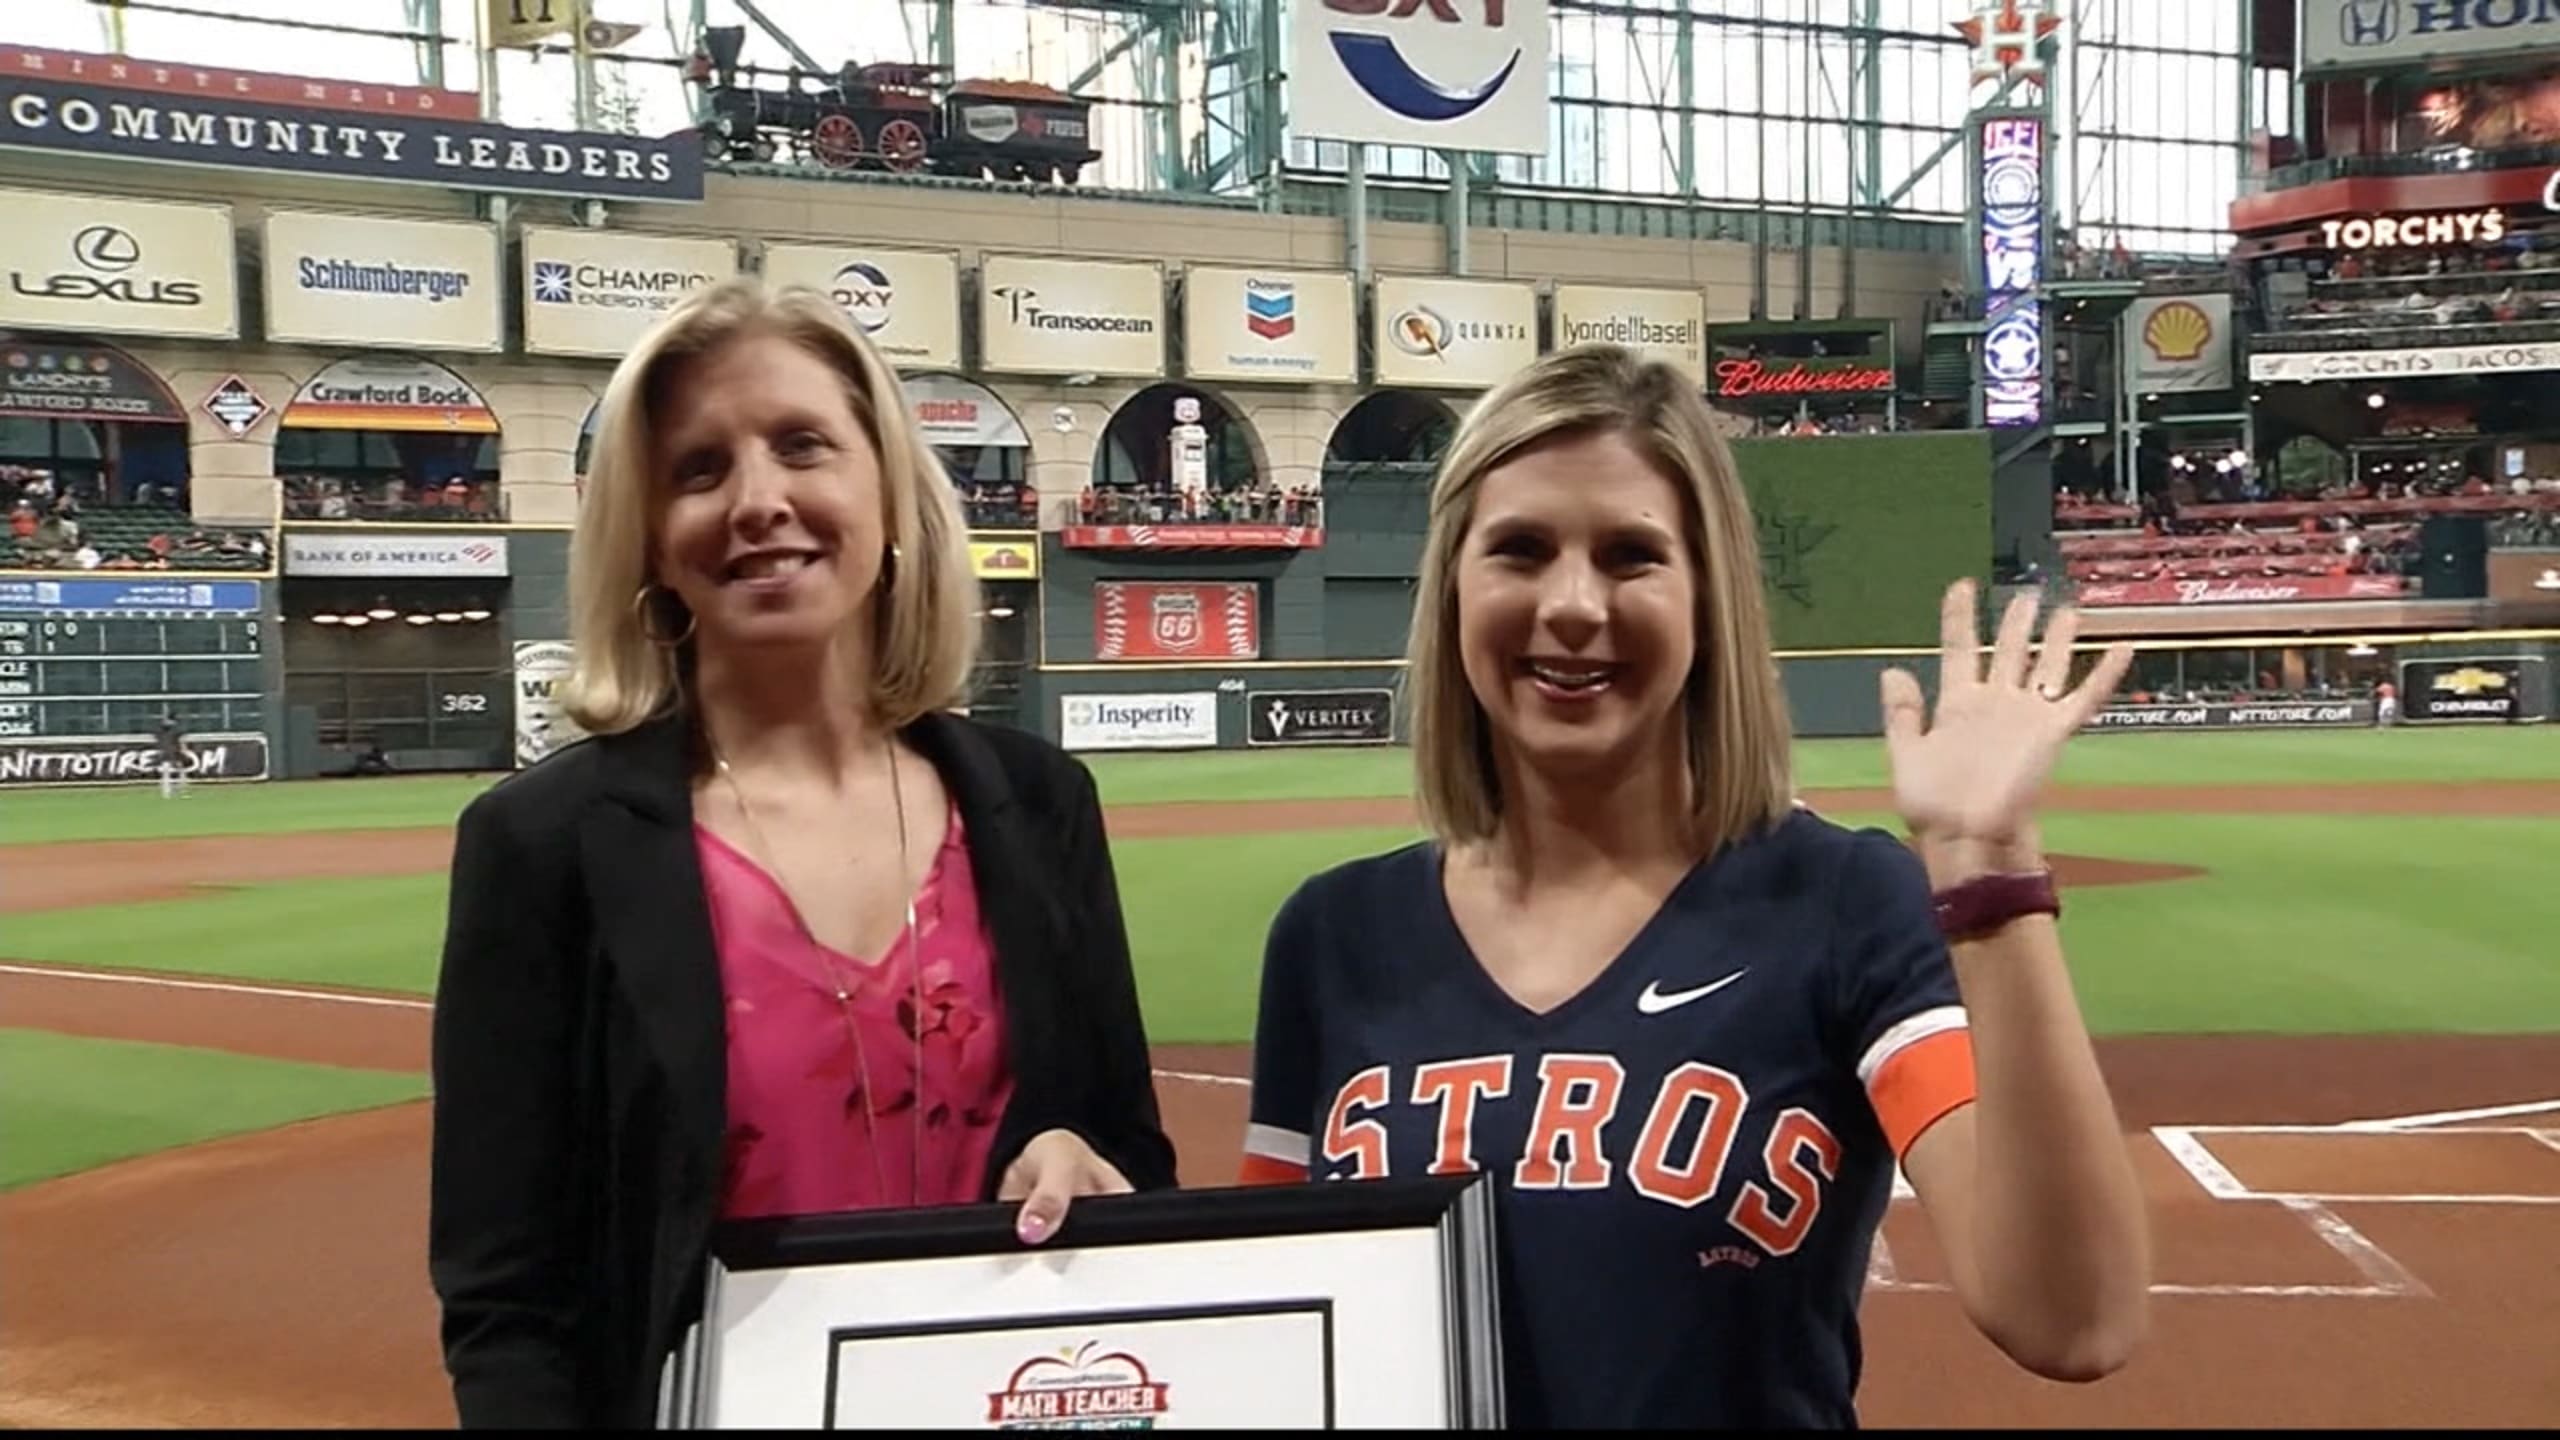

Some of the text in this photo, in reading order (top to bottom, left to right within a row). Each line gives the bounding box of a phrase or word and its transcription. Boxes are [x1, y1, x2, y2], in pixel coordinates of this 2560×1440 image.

[304, 84, 434, 110] MAID
[10, 93, 672, 182] COMMUNITY LEADERS
[10, 271, 201, 305] LEXUS
[299, 257, 469, 301] Schlumberger
[832, 288, 893, 308] OXY
[1024, 308, 1153, 334] Transocean
[1457, 321, 1527, 340] QUANTA
[1562, 312, 1698, 345] lyondellbasell
[1716, 359, 1890, 397] Budweiser
[311, 382, 471, 405] Crawford Bock
[295, 551, 458, 564] BANK OF AMERICA
[2174, 579, 2300, 602] Budweiser
[1161, 614, 1192, 637] 66
[442, 693, 488, 712] 362
[1098, 702, 1195, 728] Insperity
[1295, 708, 1375, 727] VERITEX
[1002, 1385, 1155, 1419] MATH TEACHER
